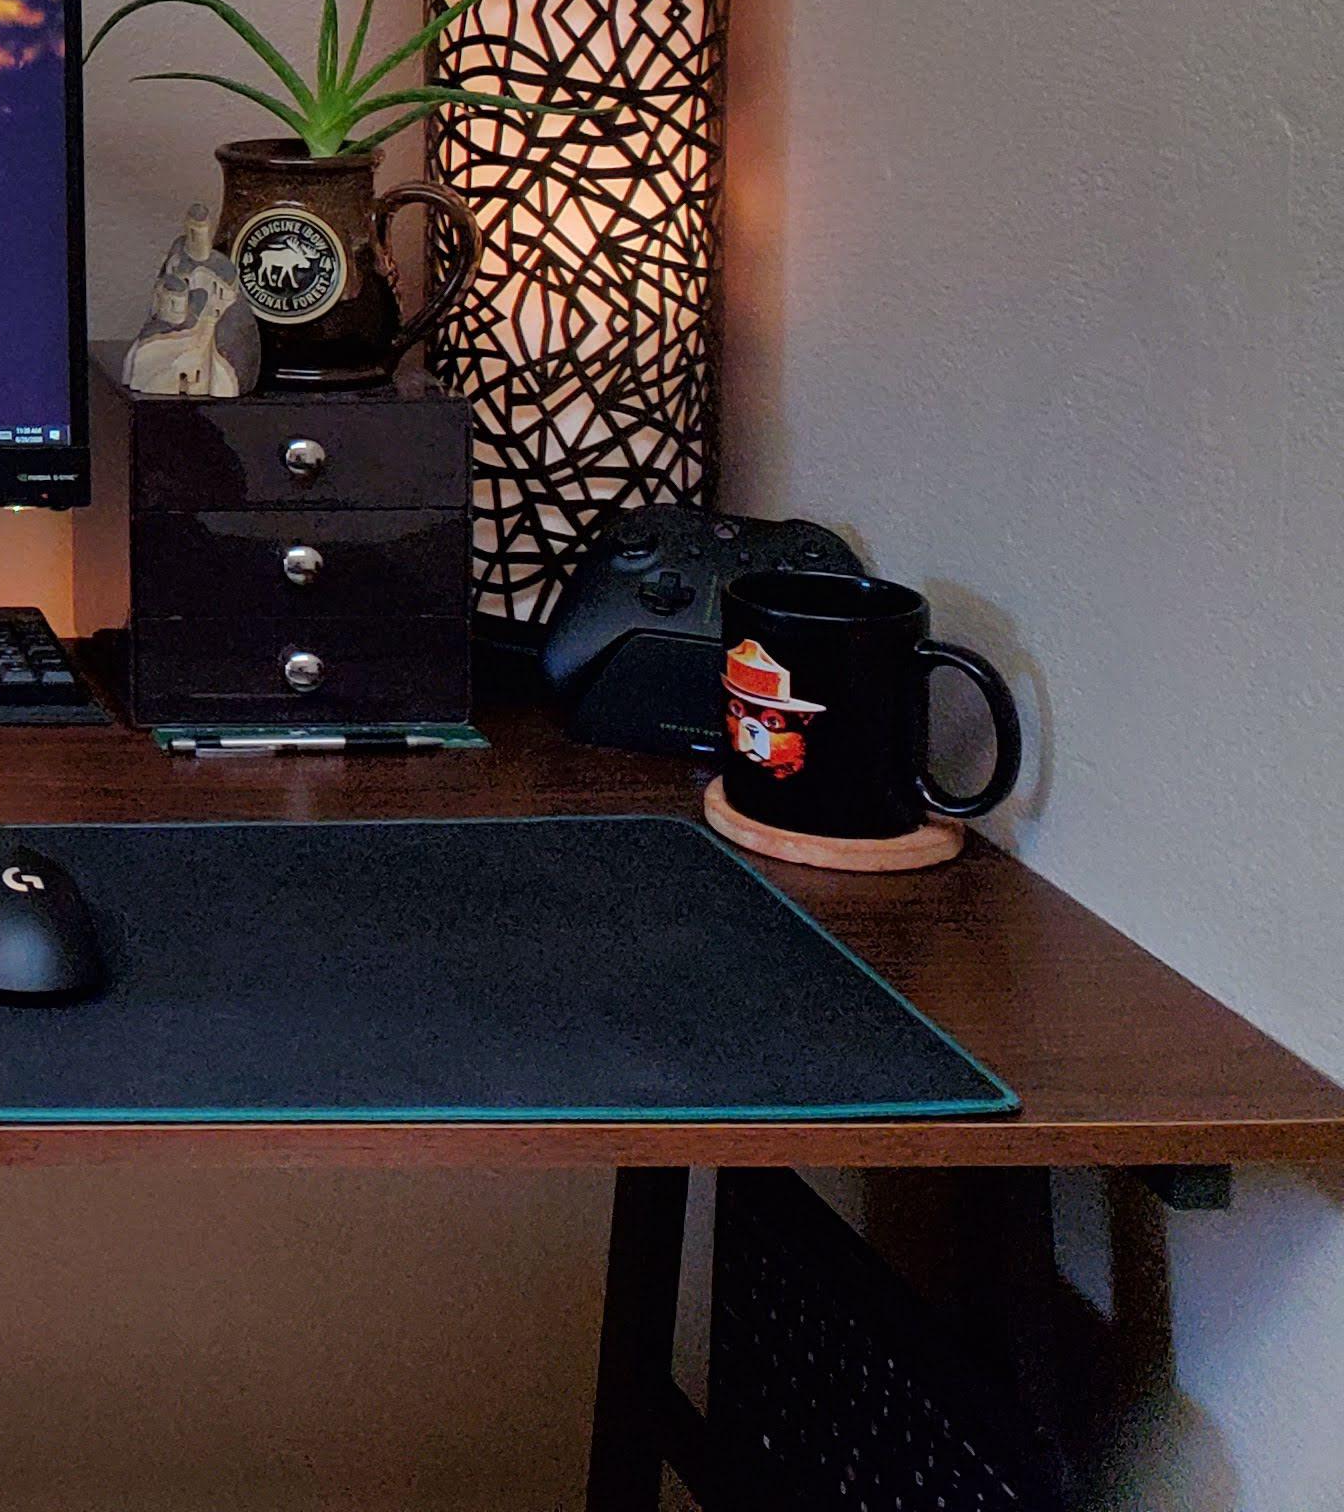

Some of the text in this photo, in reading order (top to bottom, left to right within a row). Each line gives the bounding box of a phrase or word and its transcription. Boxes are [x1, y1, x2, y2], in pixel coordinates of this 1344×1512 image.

[248, 221, 302, 248] MEDICINE
[242, 272, 330, 311] NATIONAL FOREST
